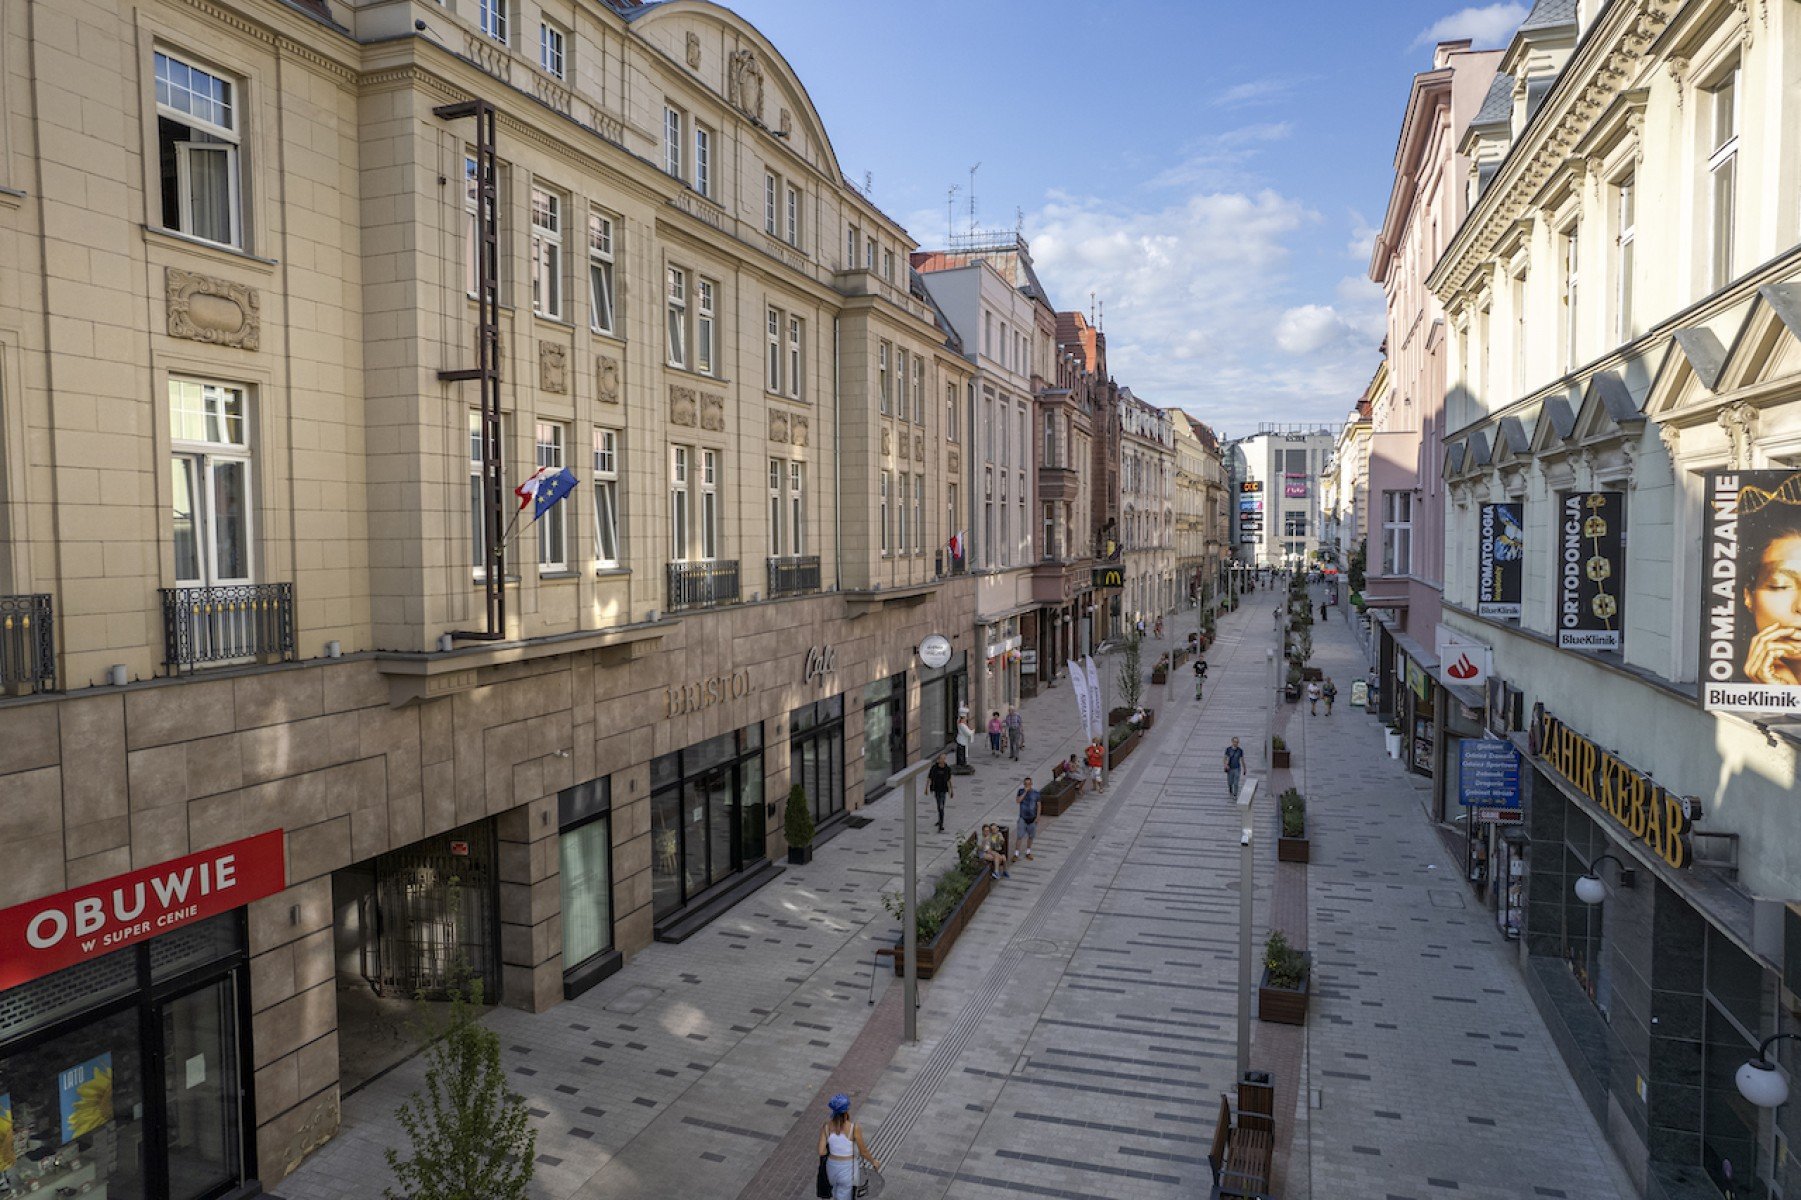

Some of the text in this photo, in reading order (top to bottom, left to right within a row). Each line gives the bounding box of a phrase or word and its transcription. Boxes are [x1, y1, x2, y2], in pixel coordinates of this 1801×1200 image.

[1481, 504, 1495, 602] STOMATOLOGIA
[1562, 496, 1581, 628] ORTODONCJA
[1709, 475, 1740, 681] ODMŁADZANIE
[1481, 605, 1519, 615] BlueKlinik
[1562, 634, 1616, 646] BlueKlinik
[667, 665, 756, 719] BRISTOL
[1709, 689, 1798, 708] BlueKlinik
[1541, 713, 1684, 869] ZAHIR KEBAB
[26, 854, 237, 949] OBUWIE
[81, 904, 198, 953] W SUPER CENIE
[63, 1066, 84, 1090] LATO
